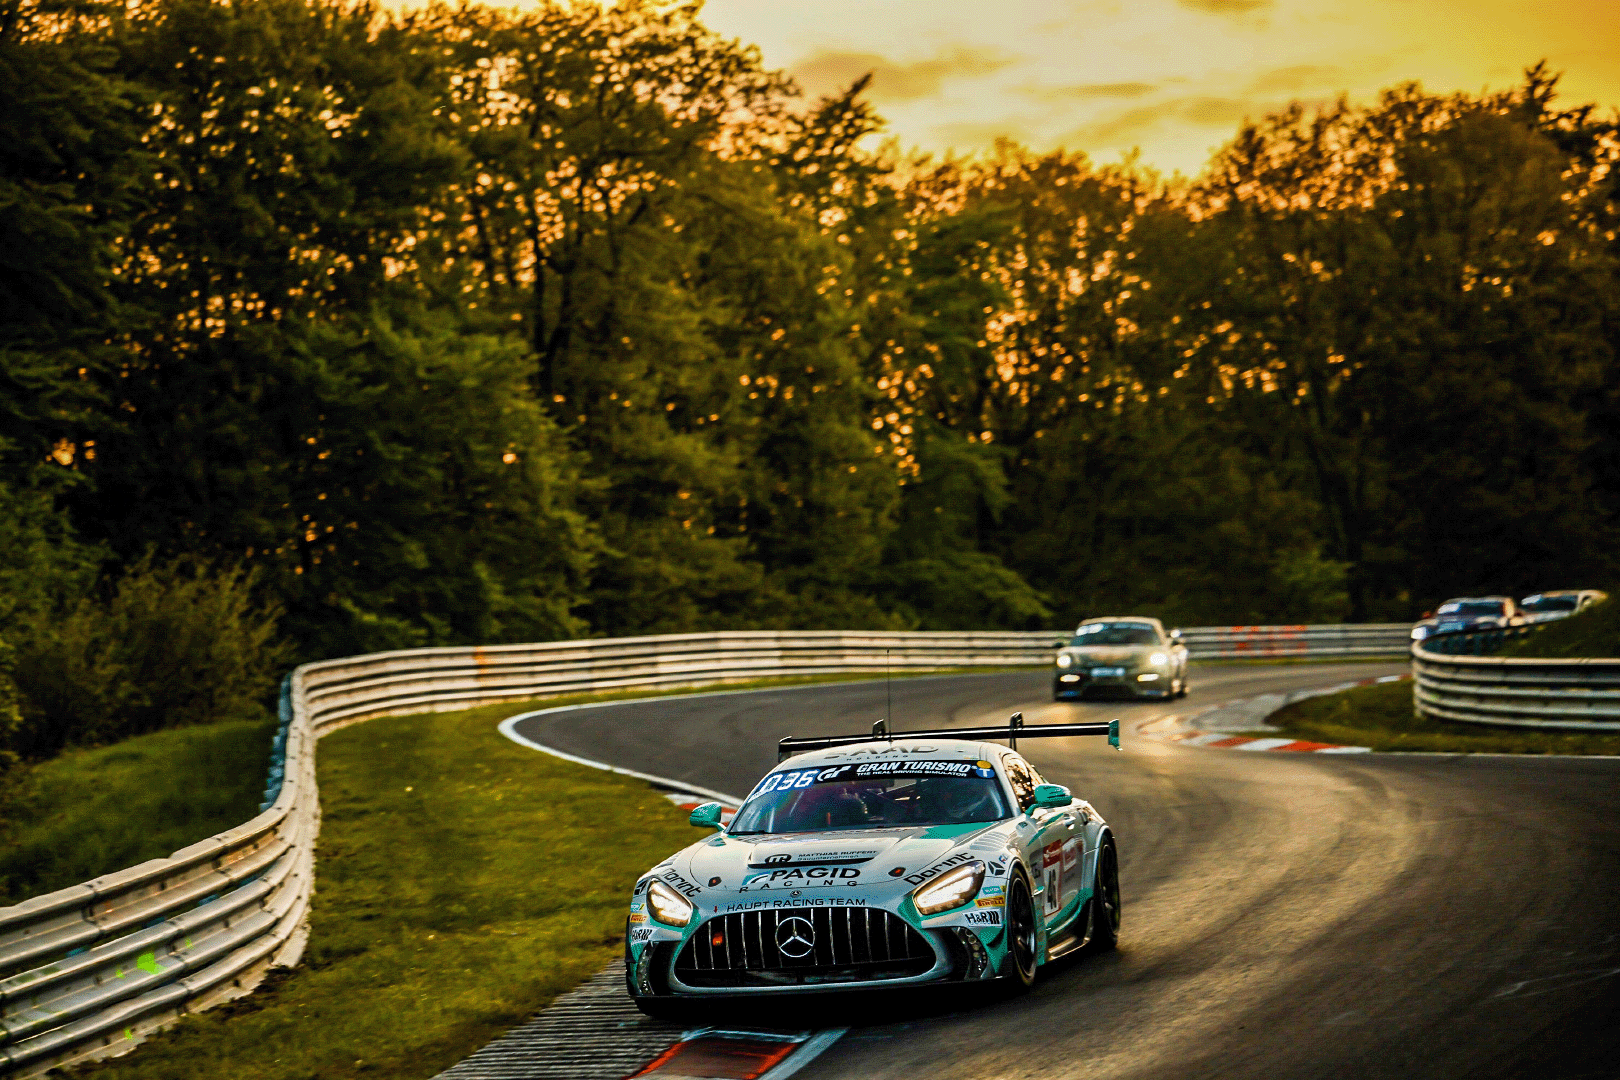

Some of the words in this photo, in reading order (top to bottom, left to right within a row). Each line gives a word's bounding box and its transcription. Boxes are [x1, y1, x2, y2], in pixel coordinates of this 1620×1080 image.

[856, 762, 901, 773] GRAN
[902, 761, 970, 773] TURISMO
[769, 867, 861, 881] PAGID
[903, 852, 975, 885] Dorint
[738, 879, 858, 893] RACING
[726, 901, 769, 912] HAUPT
[773, 899, 824, 908] RACING
[830, 898, 866, 906] TEAM
